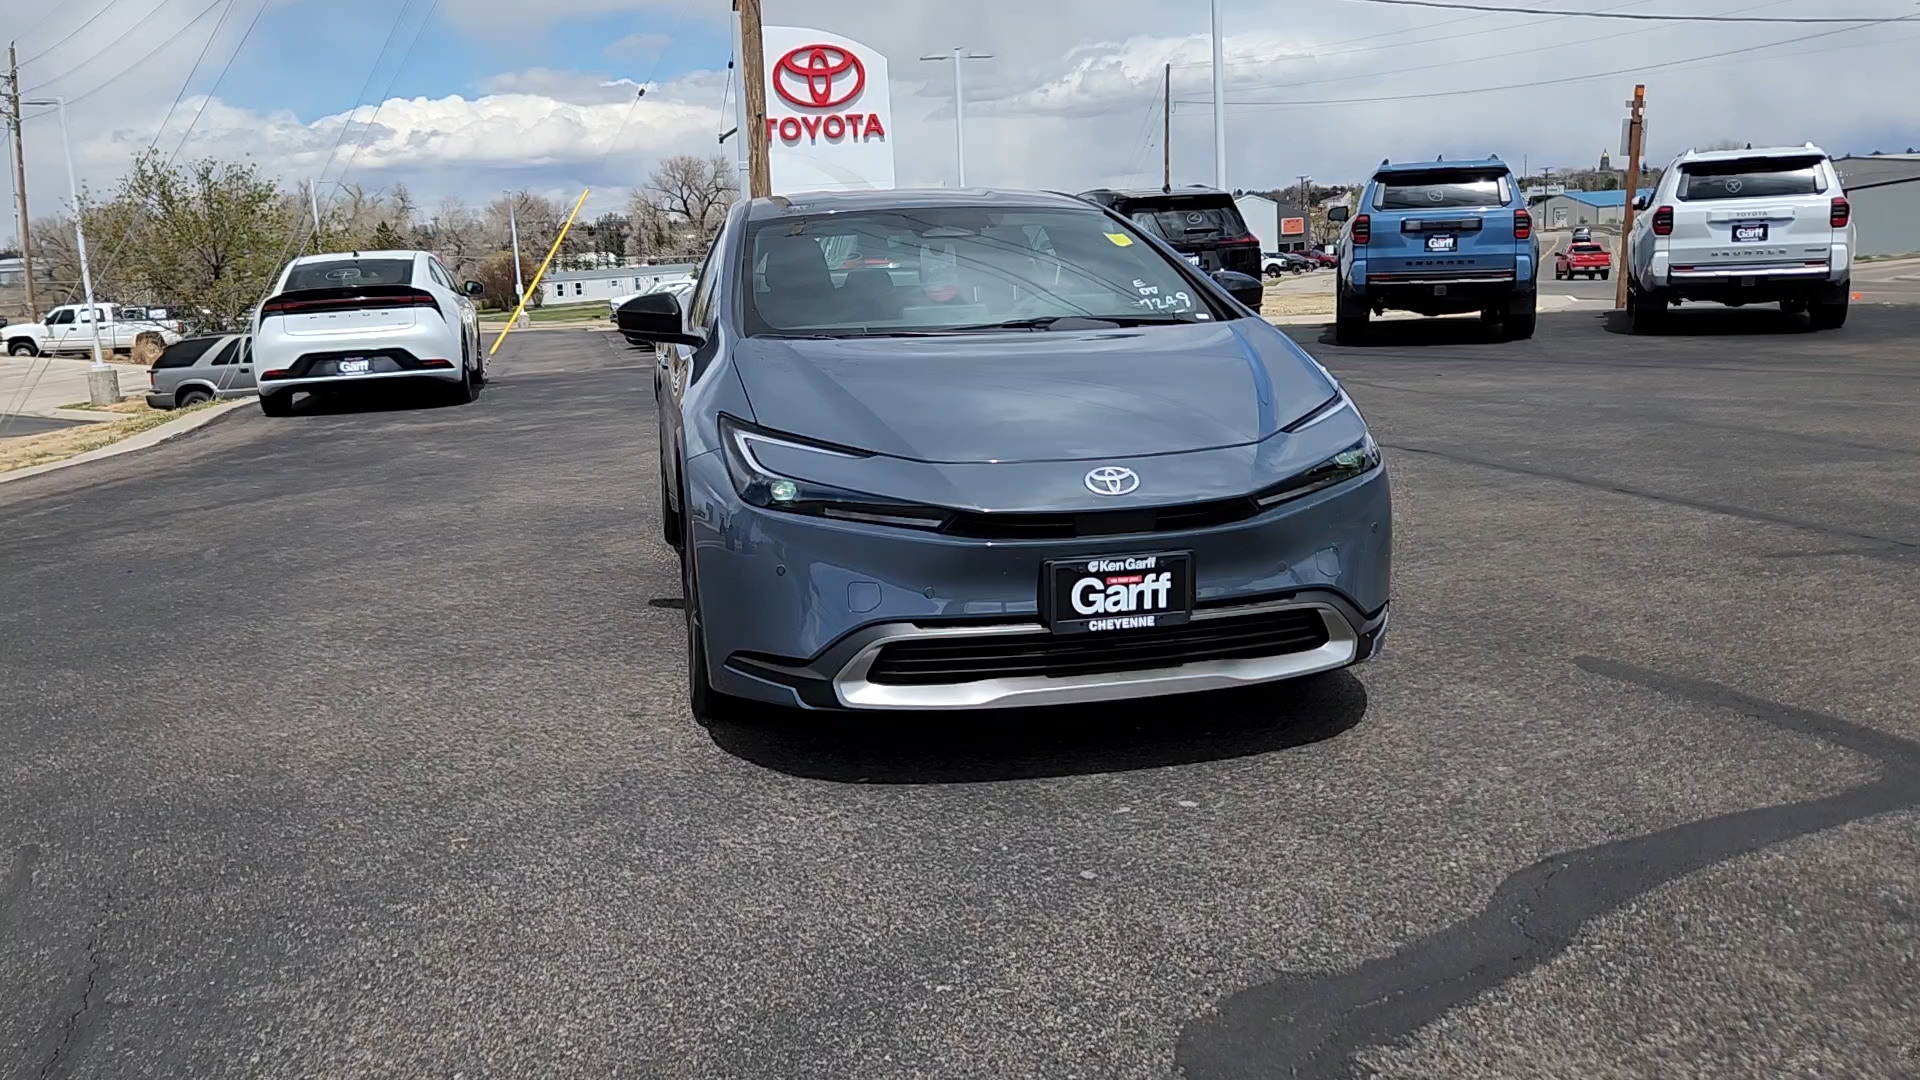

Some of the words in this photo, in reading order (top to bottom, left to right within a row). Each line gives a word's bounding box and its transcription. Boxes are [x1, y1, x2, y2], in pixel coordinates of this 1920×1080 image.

[766, 113, 885, 142] TOYOTA
[1736, 228, 1764, 239] Garff
[1428, 238, 1454, 248] Garff
[1139, 291, 1191, 310] 7249
[340, 360, 369, 372] Garff
[1099, 560, 1124, 573] Ken
[1125, 556, 1156, 570] Garff
[1071, 572, 1171, 615] Garff
[1089, 616, 1155, 631] CHEYENNE
